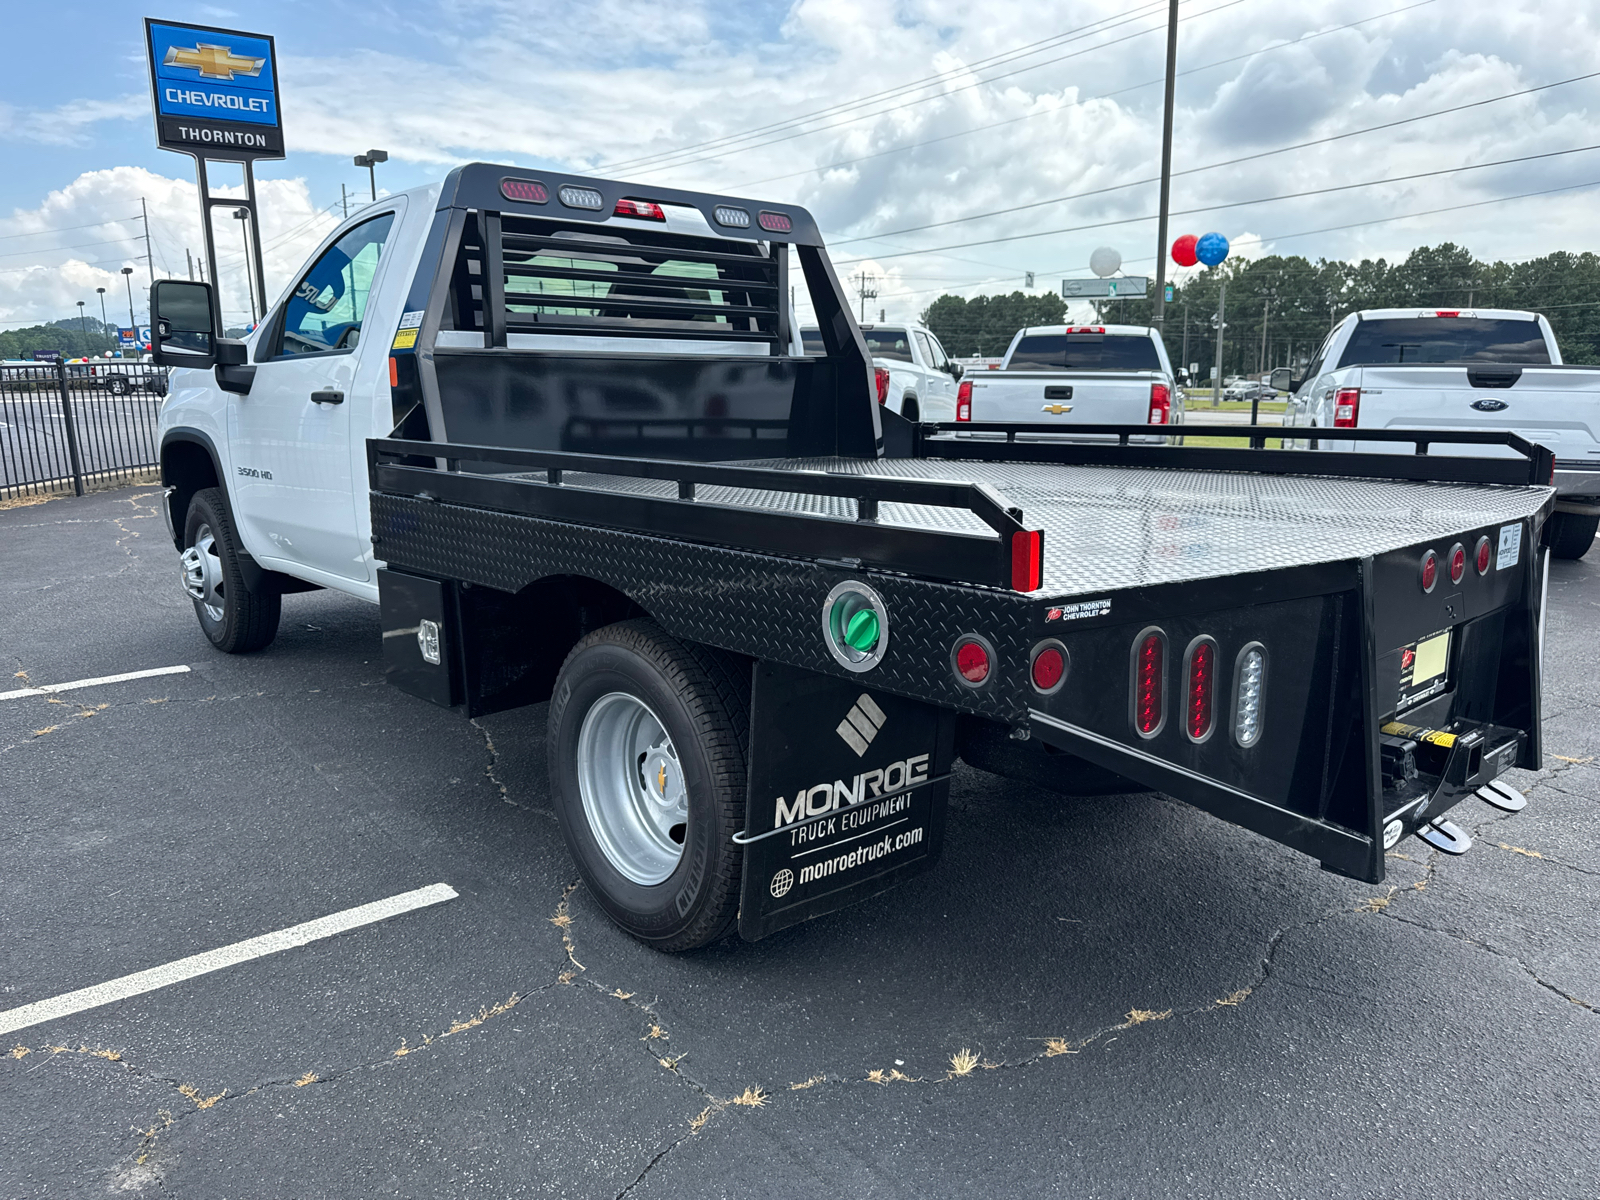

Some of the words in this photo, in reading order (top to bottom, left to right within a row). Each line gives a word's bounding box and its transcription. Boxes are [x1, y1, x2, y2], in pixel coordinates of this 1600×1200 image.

[165, 88, 269, 112] CHEVROLET
[178, 126, 266, 147] THORNTON
[237, 466, 259, 478] 3500
[261, 470, 273, 480] HD
[1063, 605, 1079, 614] JOHN
[1080, 600, 1111, 611] THORNTON
[1063, 609, 1099, 620] CHEVROLET
[774, 753, 929, 829] MONROE
[791, 817, 836, 846] TRUCK
[842, 792, 913, 831] EQUIPMENT
[799, 827, 923, 885] monroetruck.com
